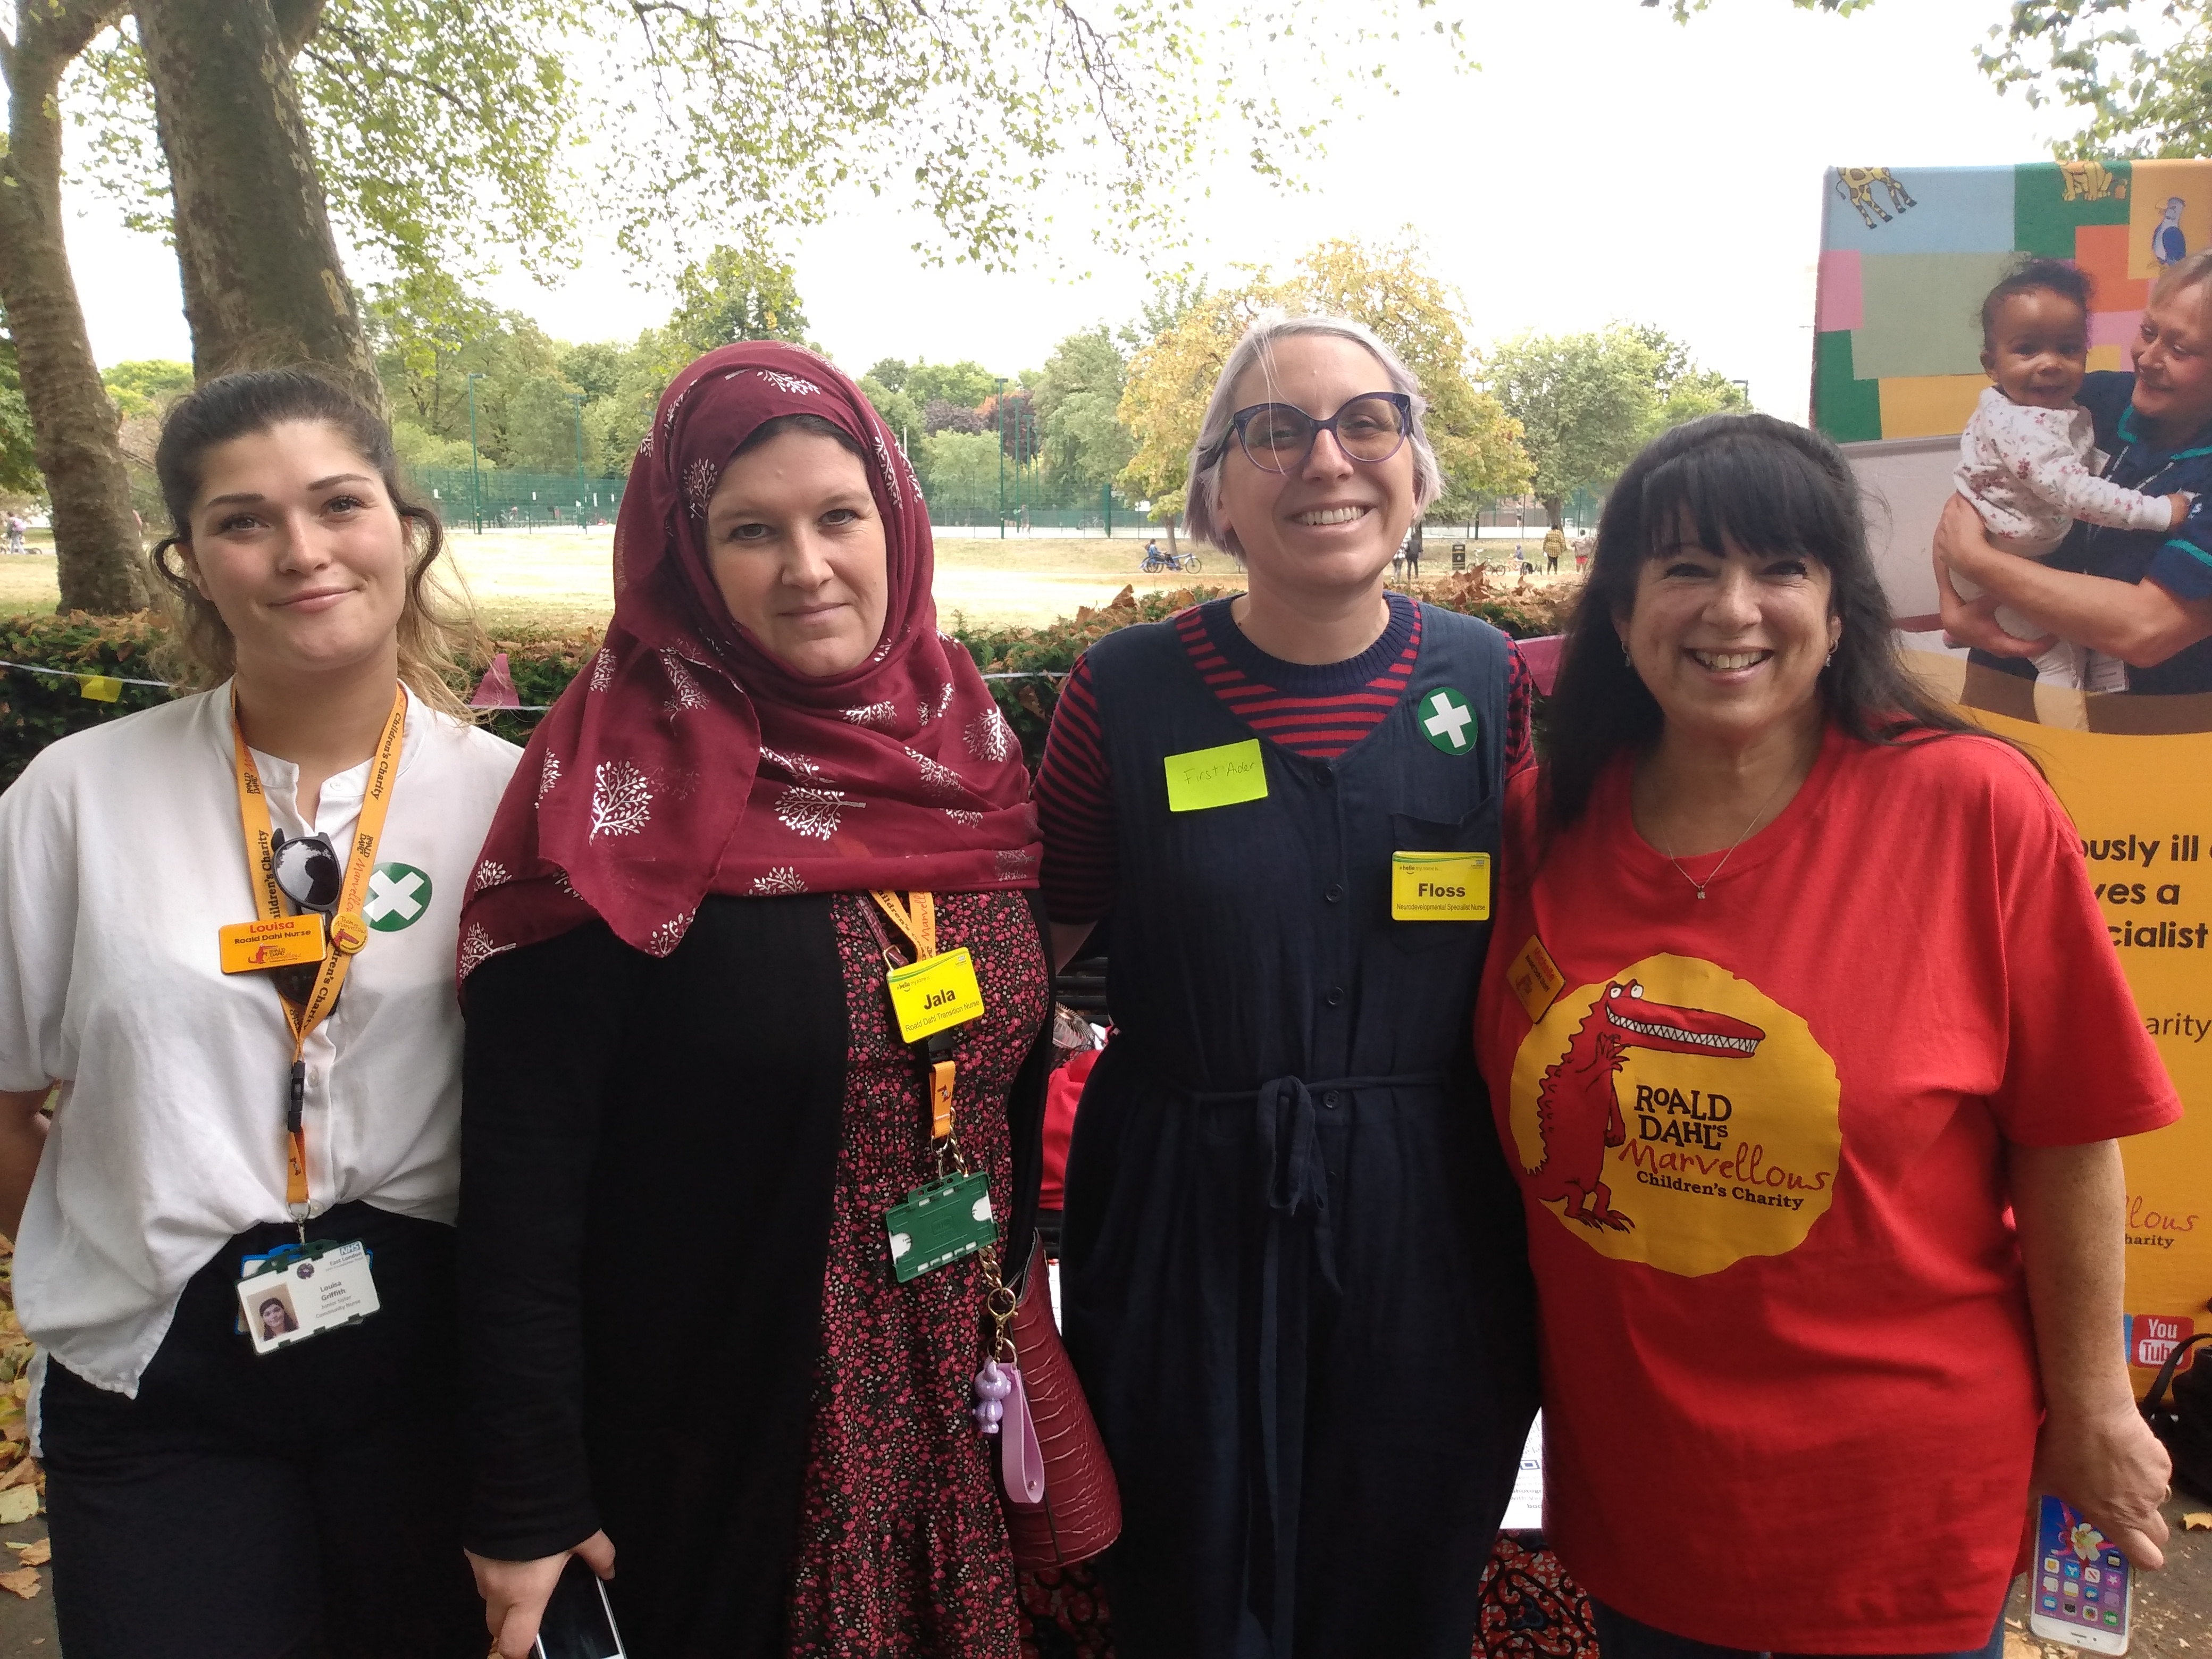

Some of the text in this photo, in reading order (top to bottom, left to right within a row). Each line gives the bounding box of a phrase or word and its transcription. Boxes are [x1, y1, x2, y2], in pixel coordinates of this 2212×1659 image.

[371, 713, 401, 801] Children's Charity
[1184, 765, 1218, 785] First
[258, 829, 272, 871] Charity
[2171, 834, 2199, 861] ill
[346, 858, 365, 911] Marvellou
[1418, 883, 1465, 898] Floss
[2156, 884, 2180, 905] a
[234, 929, 311, 944] Roald Dahl Nurse
[250, 921, 295, 934] Louisa
[923, 989, 956, 1010] Jala
[905, 1000, 980, 1032] Roald Dahl Transition Nurse
[1633, 1084, 1732, 1122] ROALD
[1618, 1137, 1831, 1191] Marvellous
[1637, 1169, 1804, 1211] Children's Charity
[2126, 1195, 2200, 1232] lous
[340, 1242, 361, 1255] NHS
[342, 1252, 363, 1261] London
[320, 1281, 342, 1293] Louisa
[321, 1288, 346, 1301] Griffith
[2148, 1319, 2177, 1339] You
[2143, 1342, 2171, 1362] Tub
